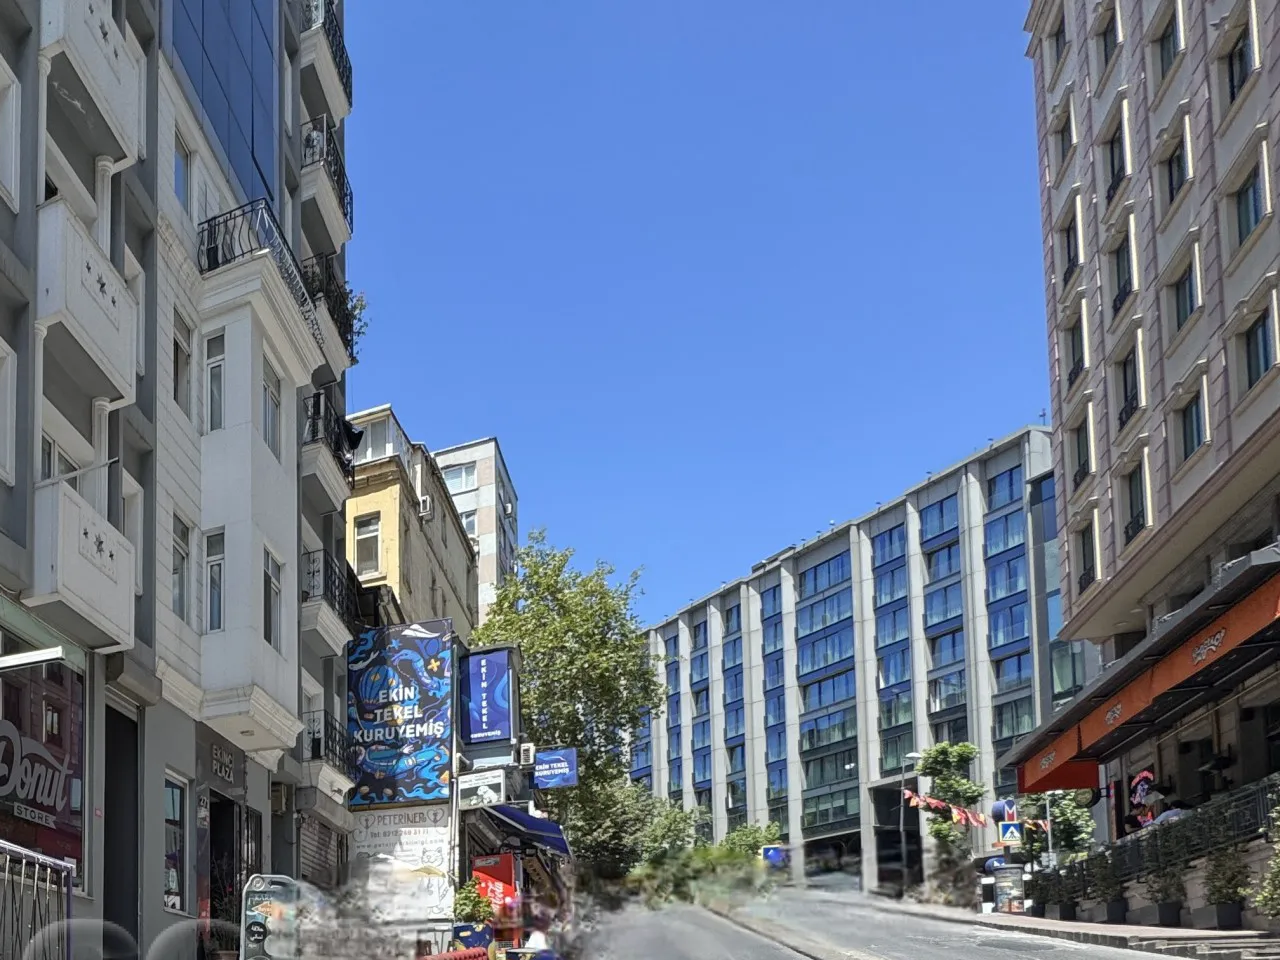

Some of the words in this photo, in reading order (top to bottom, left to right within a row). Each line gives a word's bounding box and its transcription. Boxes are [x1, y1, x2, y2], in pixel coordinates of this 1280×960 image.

[378, 684, 415, 702] EKİN
[374, 705, 423, 722] TEKEL
[354, 719, 445, 741] KURUYEMİŞ
[212, 759, 235, 784] PLAZA
[15, 806, 51, 825] STORE
